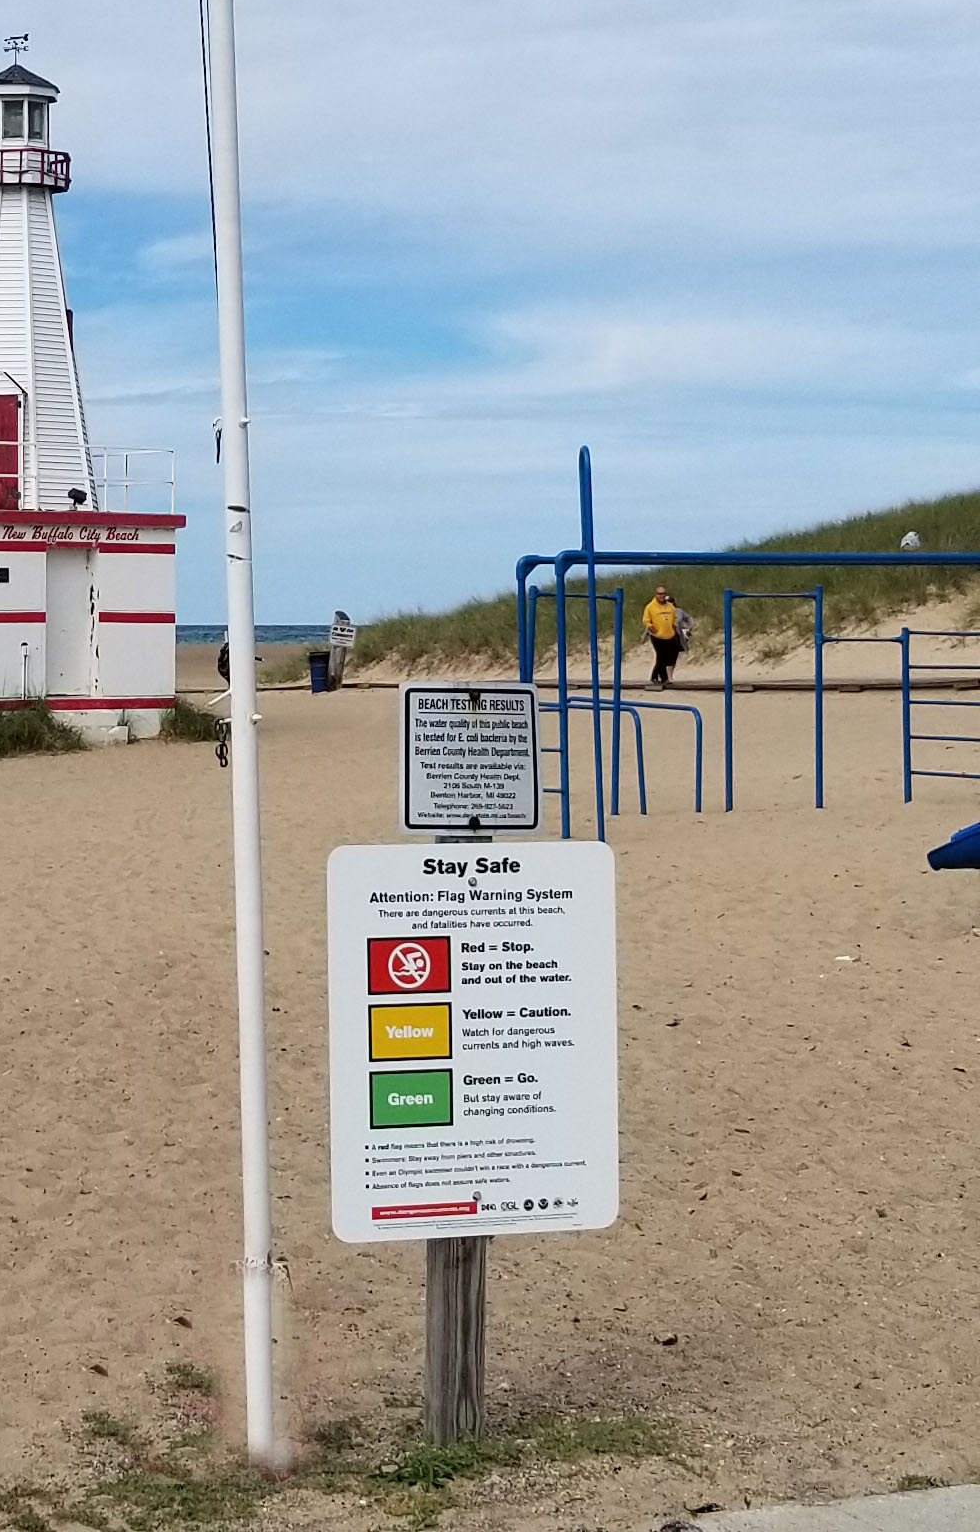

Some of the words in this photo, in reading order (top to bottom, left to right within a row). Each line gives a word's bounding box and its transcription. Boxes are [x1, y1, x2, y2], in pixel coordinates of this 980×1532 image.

[2, 526, 26, 540] New
[32, 526, 73, 544] Buffalo
[80, 527, 101, 546] City
[106, 527, 139, 541] Beach
[418, 699, 448, 709] BEACH
[451, 699, 487, 710] TESTING
[490, 700, 524, 711] RESULTS
[415, 718, 427, 727] The
[449, 719, 469, 729] quality
[472, 720, 477, 728] of
[480, 720, 490, 728] this
[492, 720, 510, 729] public
[512, 720, 528, 729] beach
[415, 733, 421, 741] is
[423, 733, 444, 741] tested
[447, 733, 456, 742] for
[458, 733, 464, 742] E.
[467, 734, 478, 742] coli
[481, 734, 507, 742] bacteria
[509, 735, 516, 744] by
[518, 735, 527, 743] the
[415, 747, 440, 755] Berrien
[443, 747, 466, 757] County
[468, 747, 489, 756] Health
[454, 773, 478, 781] County
[422, 858, 468, 877] Stay
[475, 857, 522, 874] Safe
[369, 891, 434, 904] Attention:
[437, 891, 465, 903] Flag
[469, 889, 522, 903] Warning
[526, 888, 573, 902] System
[378, 909, 403, 918] There
[422, 909, 468, 919] dangerous
[471, 907, 506, 916] currents
[508, 907, 517, 915] at
[519, 906, 535, 915] this
[537, 906, 566, 916] beach,
[412, 921, 428, 929] and
[430, 920, 467, 929] fatalities
[470, 920, 491, 928] have
[493, 919, 533, 928] occurred.
[460, 942, 485, 953] Red
[502, 941, 535, 954] Stop.
[461, 961, 487, 972] Stay
[489, 962, 503, 970] on
[506, 961, 523, 970] the
[526, 960, 558, 969] beach
[461, 976, 482, 985] and
[484, 976, 503, 984] out
[506, 975, 517, 983] of
[520, 974, 536, 983] the
[538, 974, 572, 983] water.
[462, 1009, 503, 1020] Yellow
[519, 1007, 572, 1018] Caution.
[385, 1025, 434, 1039] Yellow
[462, 1028, 490, 1037] Watch
[491, 1027, 505, 1036] for
[507, 1026, 555, 1037] dangerous
[462, 1040, 500, 1050] currents
[502, 1039, 520, 1048] and
[522, 1038, 542, 1049] high
[544, 1038, 575, 1047] waves.
[463, 1074, 501, 1085] Green
[517, 1073, 538, 1084] Go.
[387, 1092, 434, 1106] Green
[463, 1094, 480, 1103] But
[482, 1093, 501, 1103] stay
[503, 1093, 530, 1101] aware
[533, 1091, 542, 1100] of
[463, 1106, 505, 1117] changing
[507, 1104, 556, 1115] conditions.
